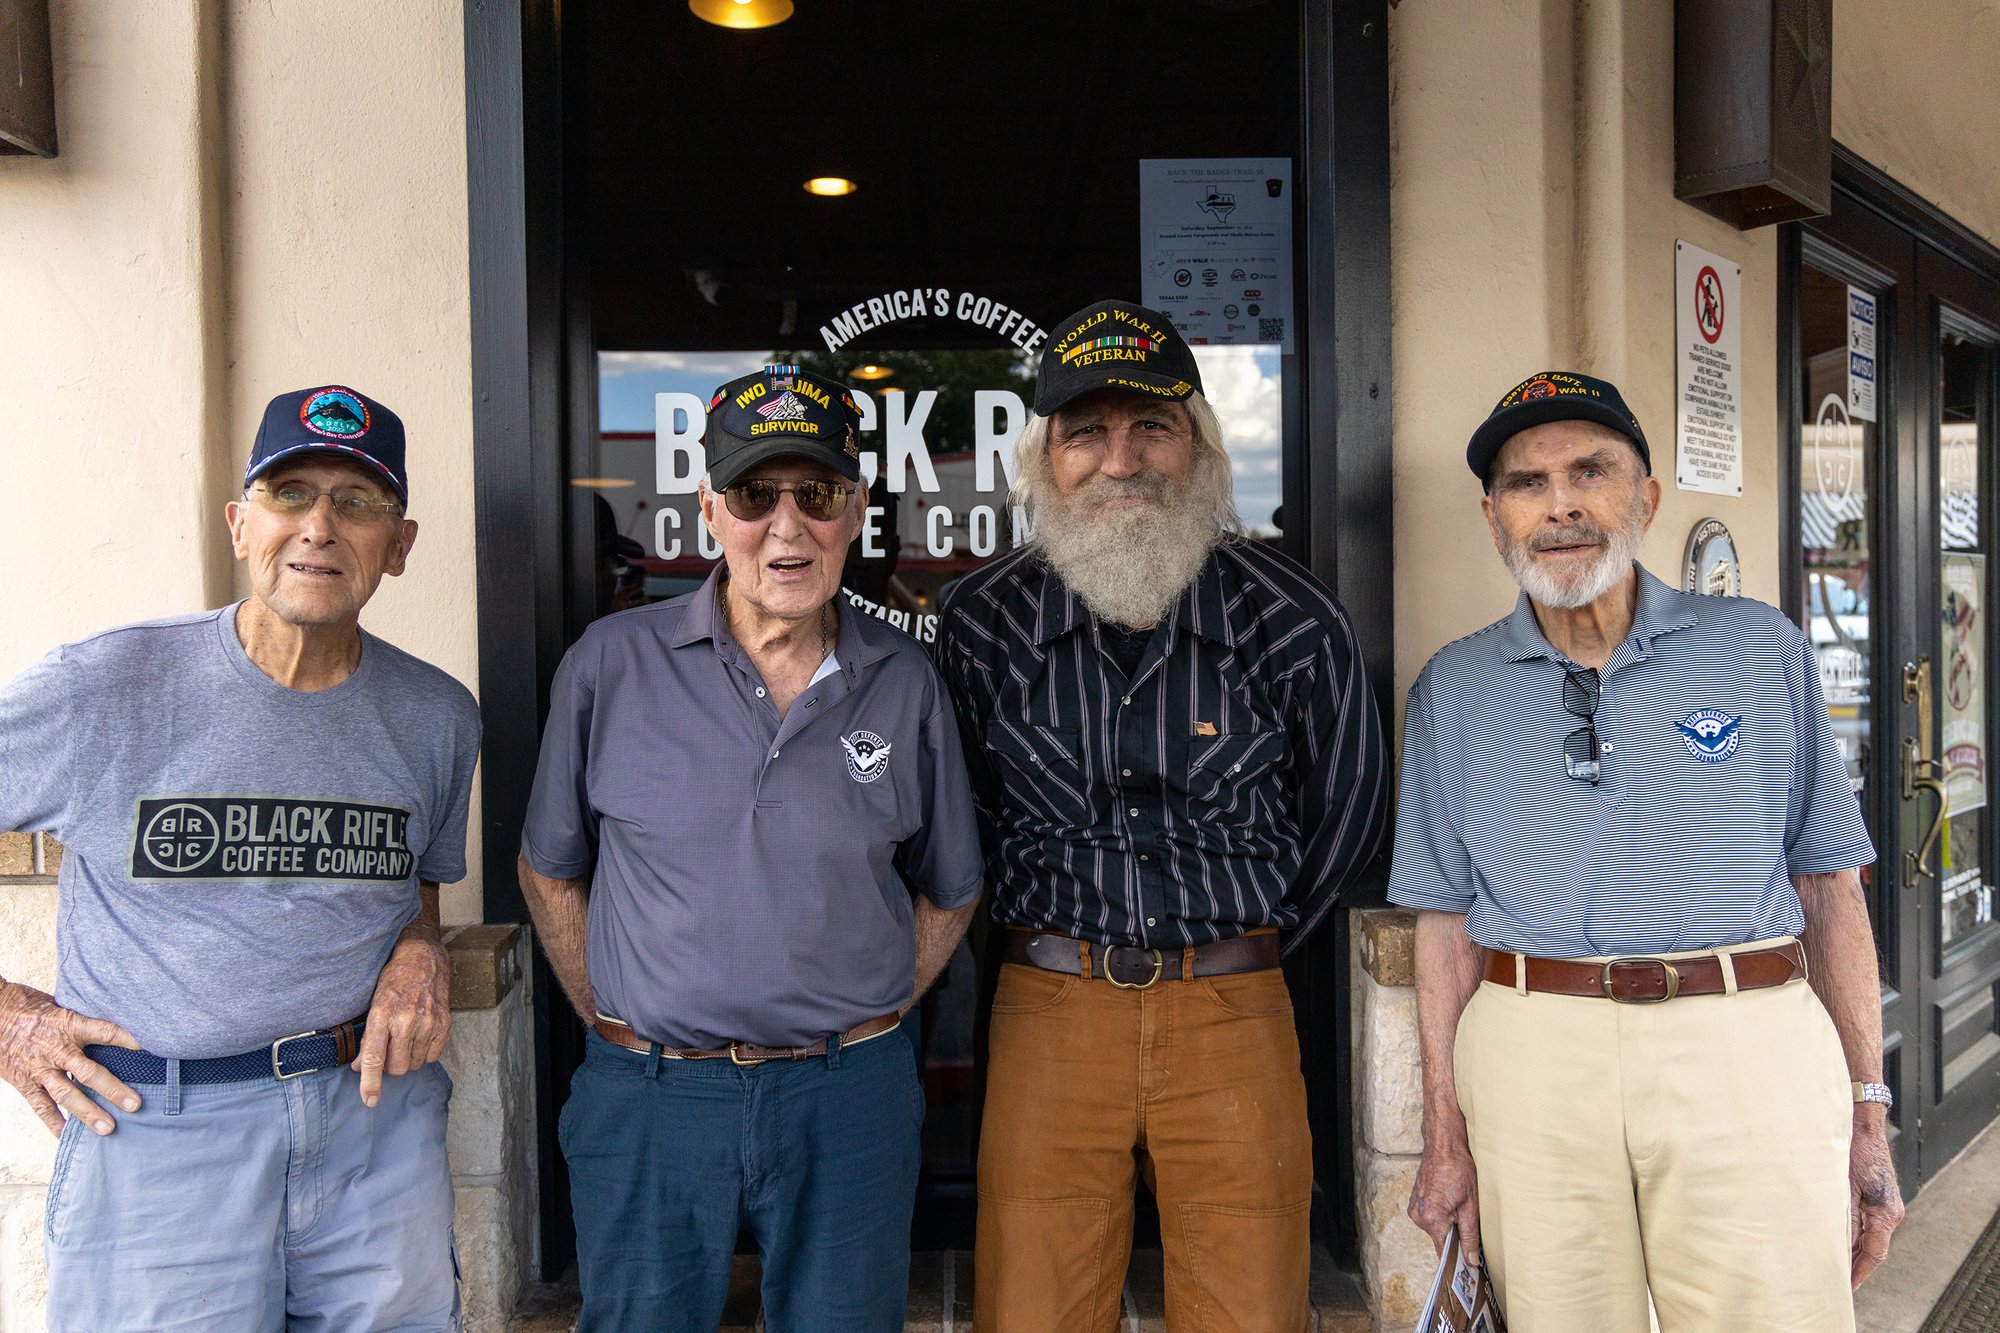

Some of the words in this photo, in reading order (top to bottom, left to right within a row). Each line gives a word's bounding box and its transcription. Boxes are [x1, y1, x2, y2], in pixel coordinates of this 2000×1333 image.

[819, 288, 950, 353] AMERICA'S
[956, 292, 1049, 357] COFFEE
[1054, 311, 1108, 355] WORLD
[1113, 309, 1151, 334] WAR
[1073, 348, 1146, 368] VETERAN
[735, 382, 767, 409] IWO
[792, 379, 831, 410] JIMA
[1106, 378, 1174, 397] PROUDLY
[1558, 387, 1587, 395] WAR
[326, 421, 355, 431] DELTA
[750, 420, 819, 436] SURVIVOR
[655, 390, 941, 495] BCK
[655, 506, 886, 561] COE
[842, 586, 941, 643] STABLIS
[224, 804, 334, 845] BLACK
[221, 846, 304, 873] COFFEE
[315, 848, 410, 876] COMPANY
